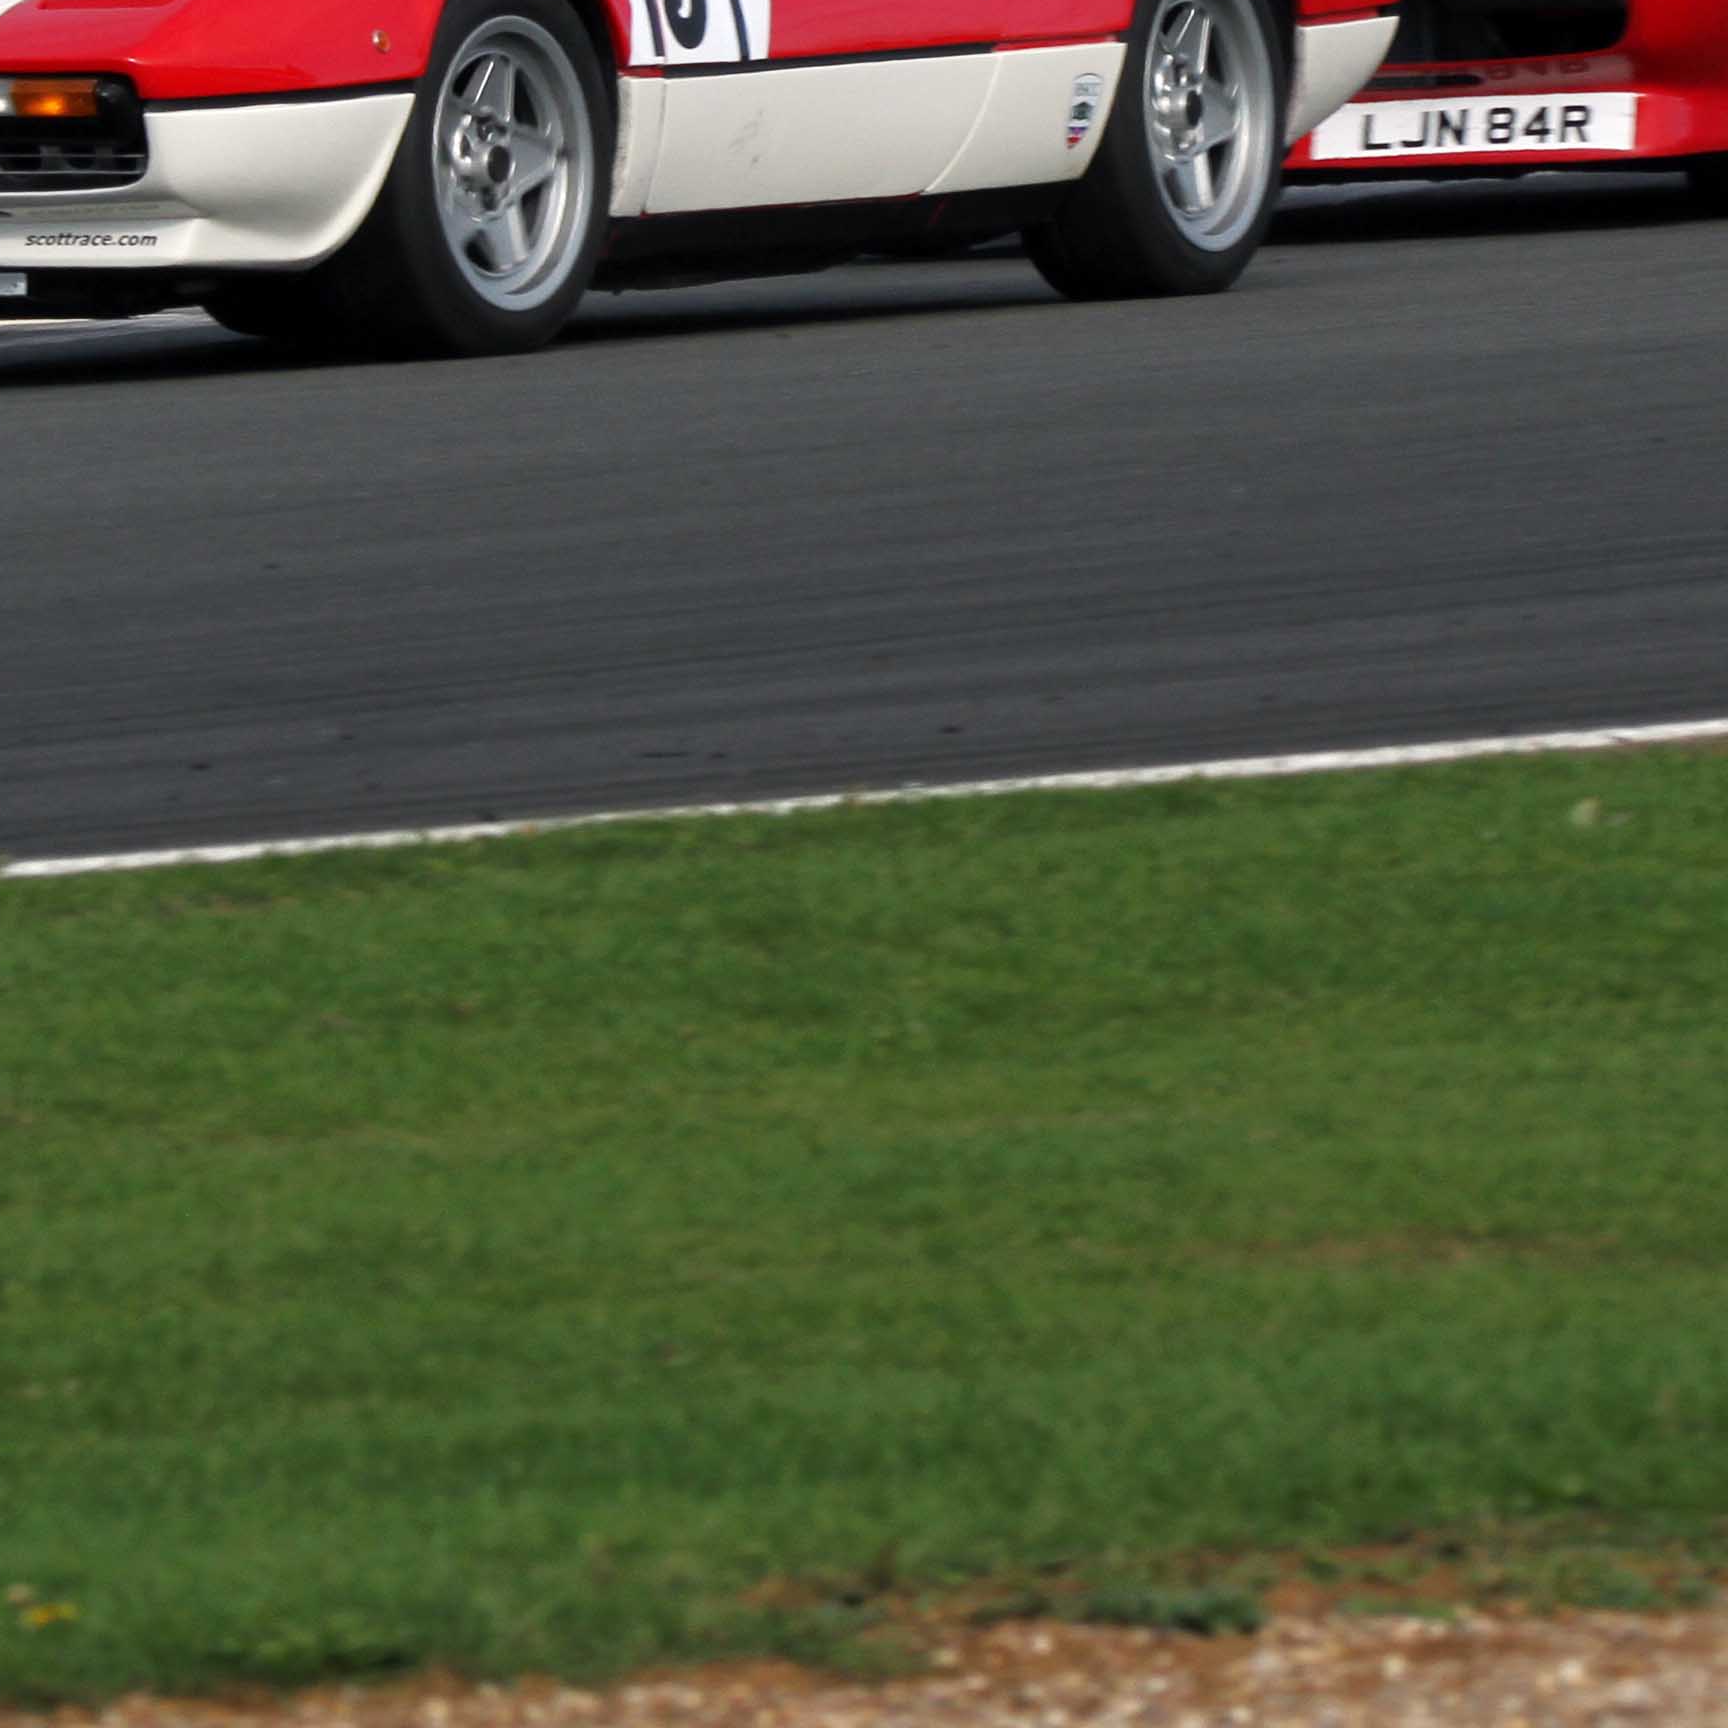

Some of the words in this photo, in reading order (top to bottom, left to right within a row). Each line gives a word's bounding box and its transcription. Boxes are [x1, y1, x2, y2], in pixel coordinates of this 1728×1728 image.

[1361, 108, 1470, 151] LJN
[1484, 104, 1594, 145] 84R
[24, 232, 159, 247] scottrace.com
